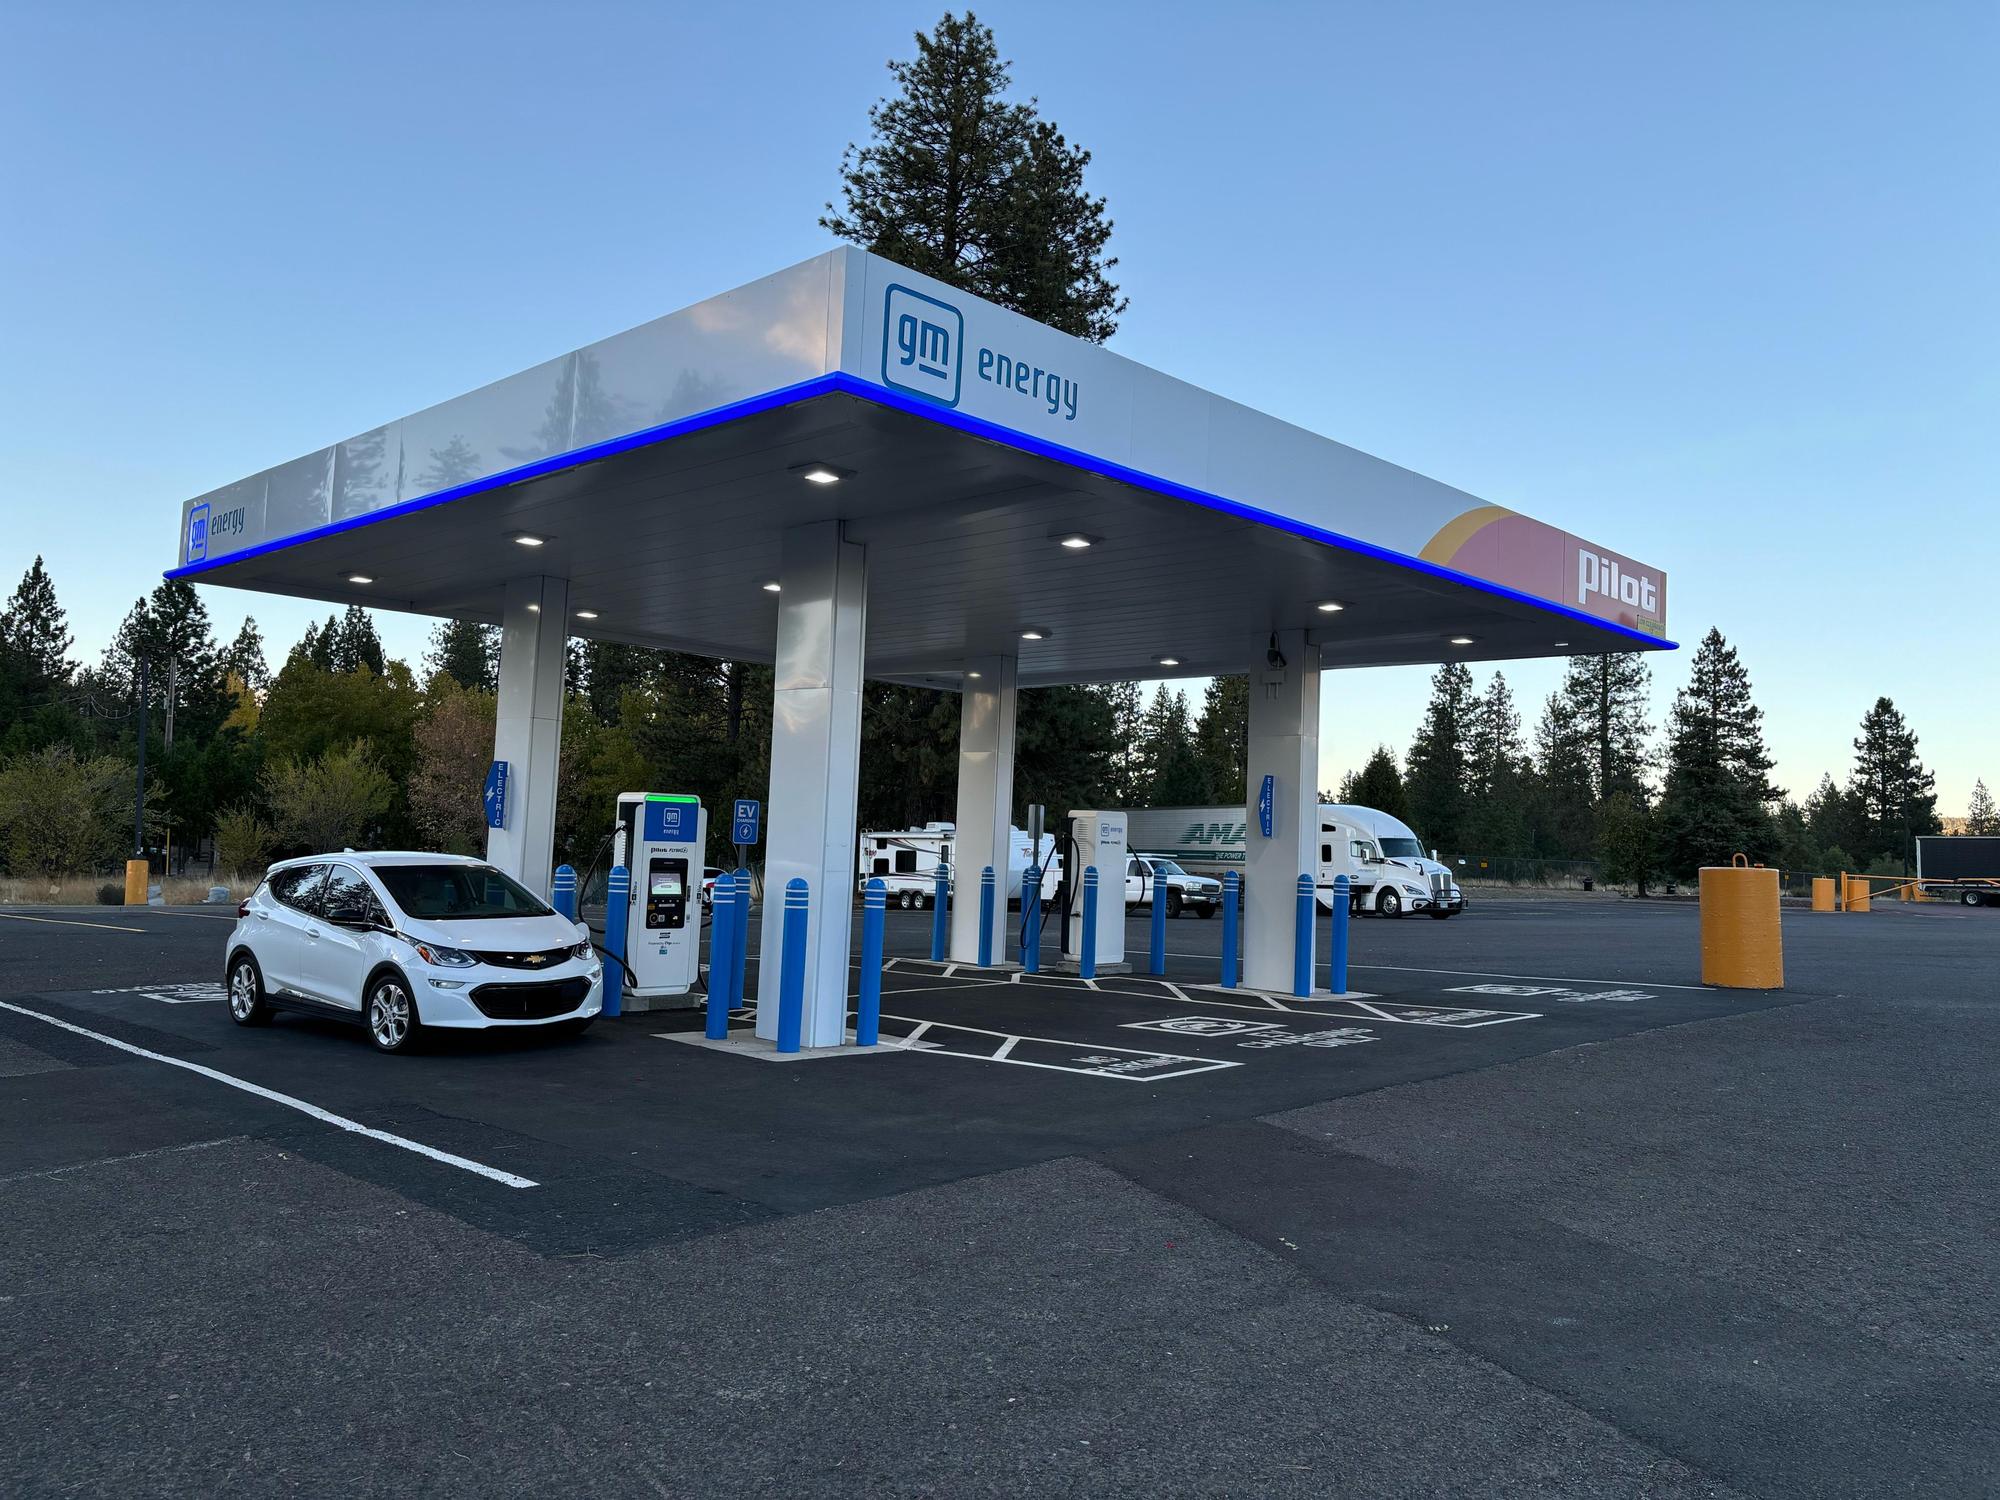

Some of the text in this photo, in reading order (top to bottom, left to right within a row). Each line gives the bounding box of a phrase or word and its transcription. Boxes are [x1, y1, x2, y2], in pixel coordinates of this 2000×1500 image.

[898, 313, 1078, 421] gm energy
[211, 506, 245, 535] energy
[494, 763, 504, 826] ELECTRIC
[737, 804, 756, 818] EV
